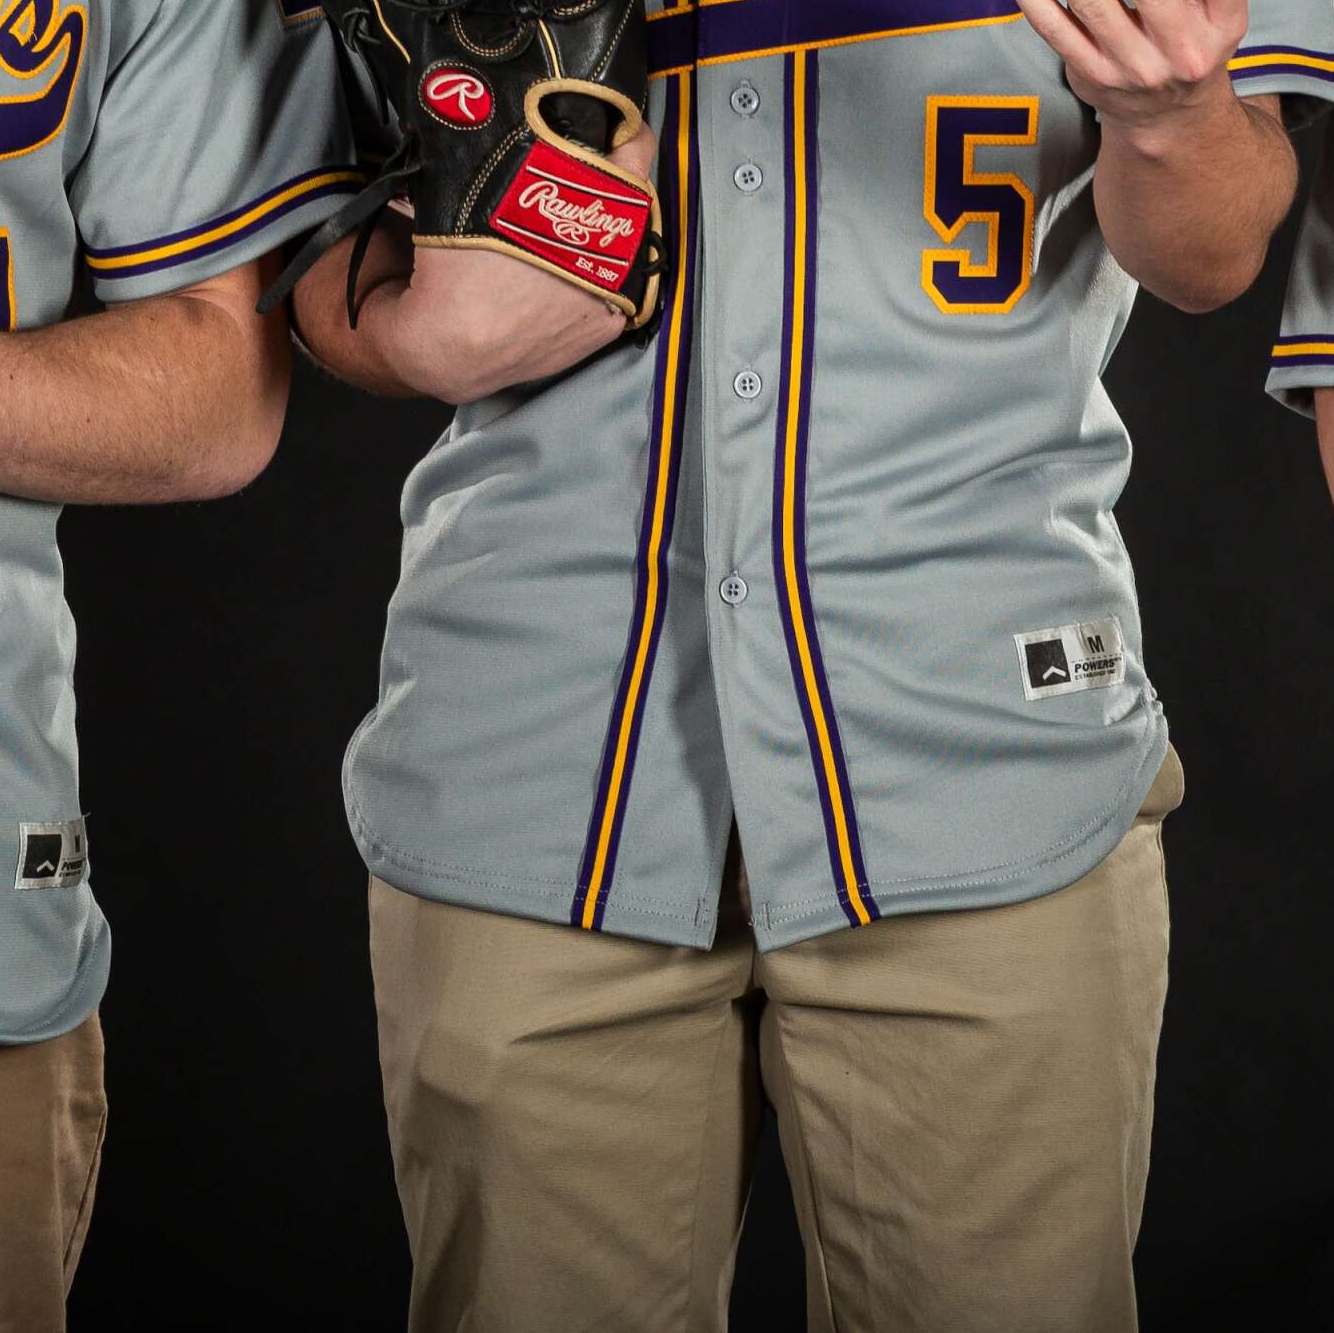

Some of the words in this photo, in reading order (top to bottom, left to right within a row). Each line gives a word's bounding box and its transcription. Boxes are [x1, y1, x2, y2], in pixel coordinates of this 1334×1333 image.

[518, 180, 634, 247] Rawlings
[921, 95, 1040, 315] 5
[1087, 634, 1105, 654] M
[1074, 658, 1115, 674] POWERS
